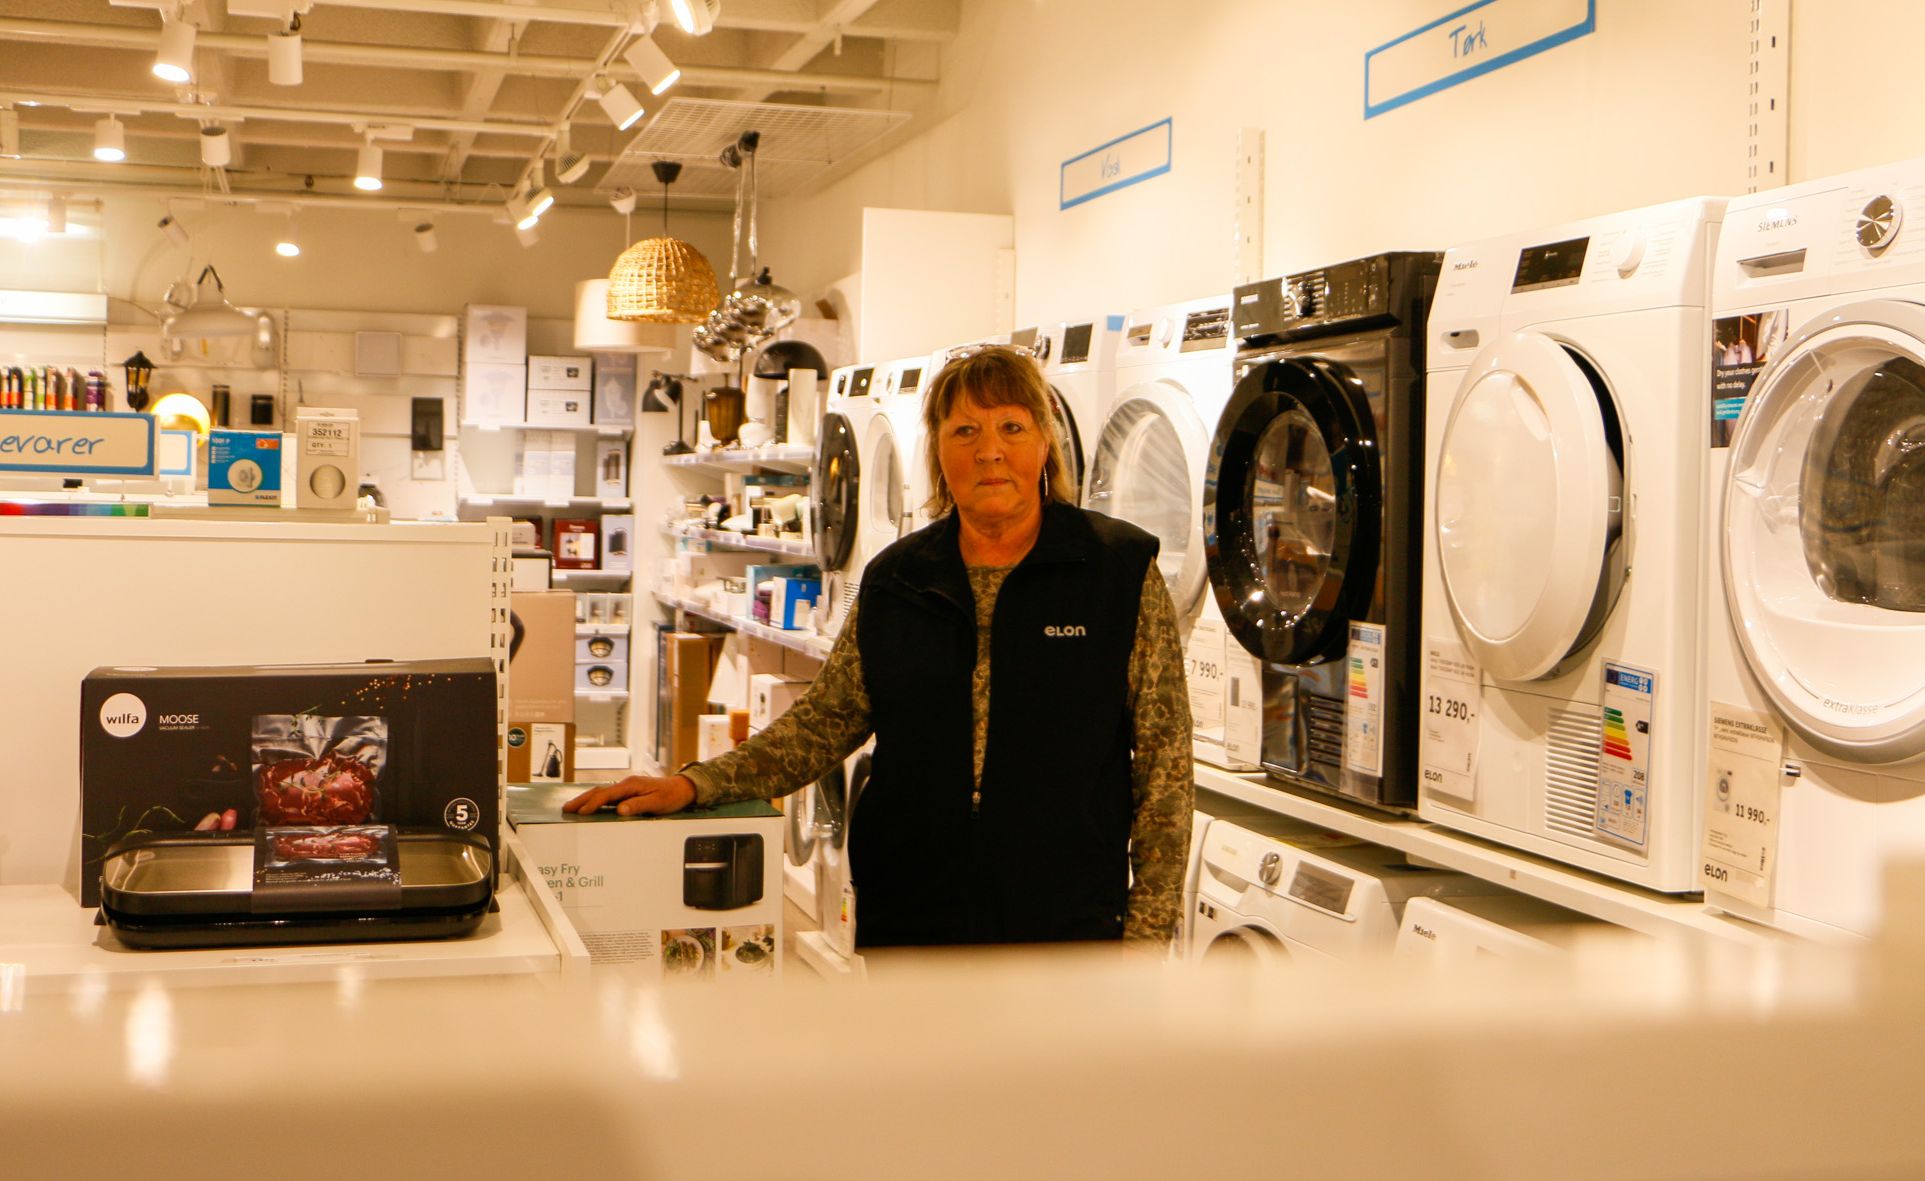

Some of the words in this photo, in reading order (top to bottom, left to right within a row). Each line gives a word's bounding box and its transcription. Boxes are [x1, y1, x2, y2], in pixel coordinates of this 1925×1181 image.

[312, 428, 342, 438] 352112
[0, 435, 104, 455] evarer
[1429, 695, 1442, 715] 13
[1446, 698, 1475, 724] 290,-
[106, 713, 139, 724] wilfa
[160, 714, 199, 724] MOOSE
[456, 804, 468, 821] 5
[1736, 803, 1745, 818] 11
[1747, 807, 1770, 825] 990,-
[537, 866, 558, 876] asy
[561, 863, 580, 876] Fry
[546, 879, 563, 888] en
[566, 876, 575, 888] &
[578, 875, 604, 888] Grill
